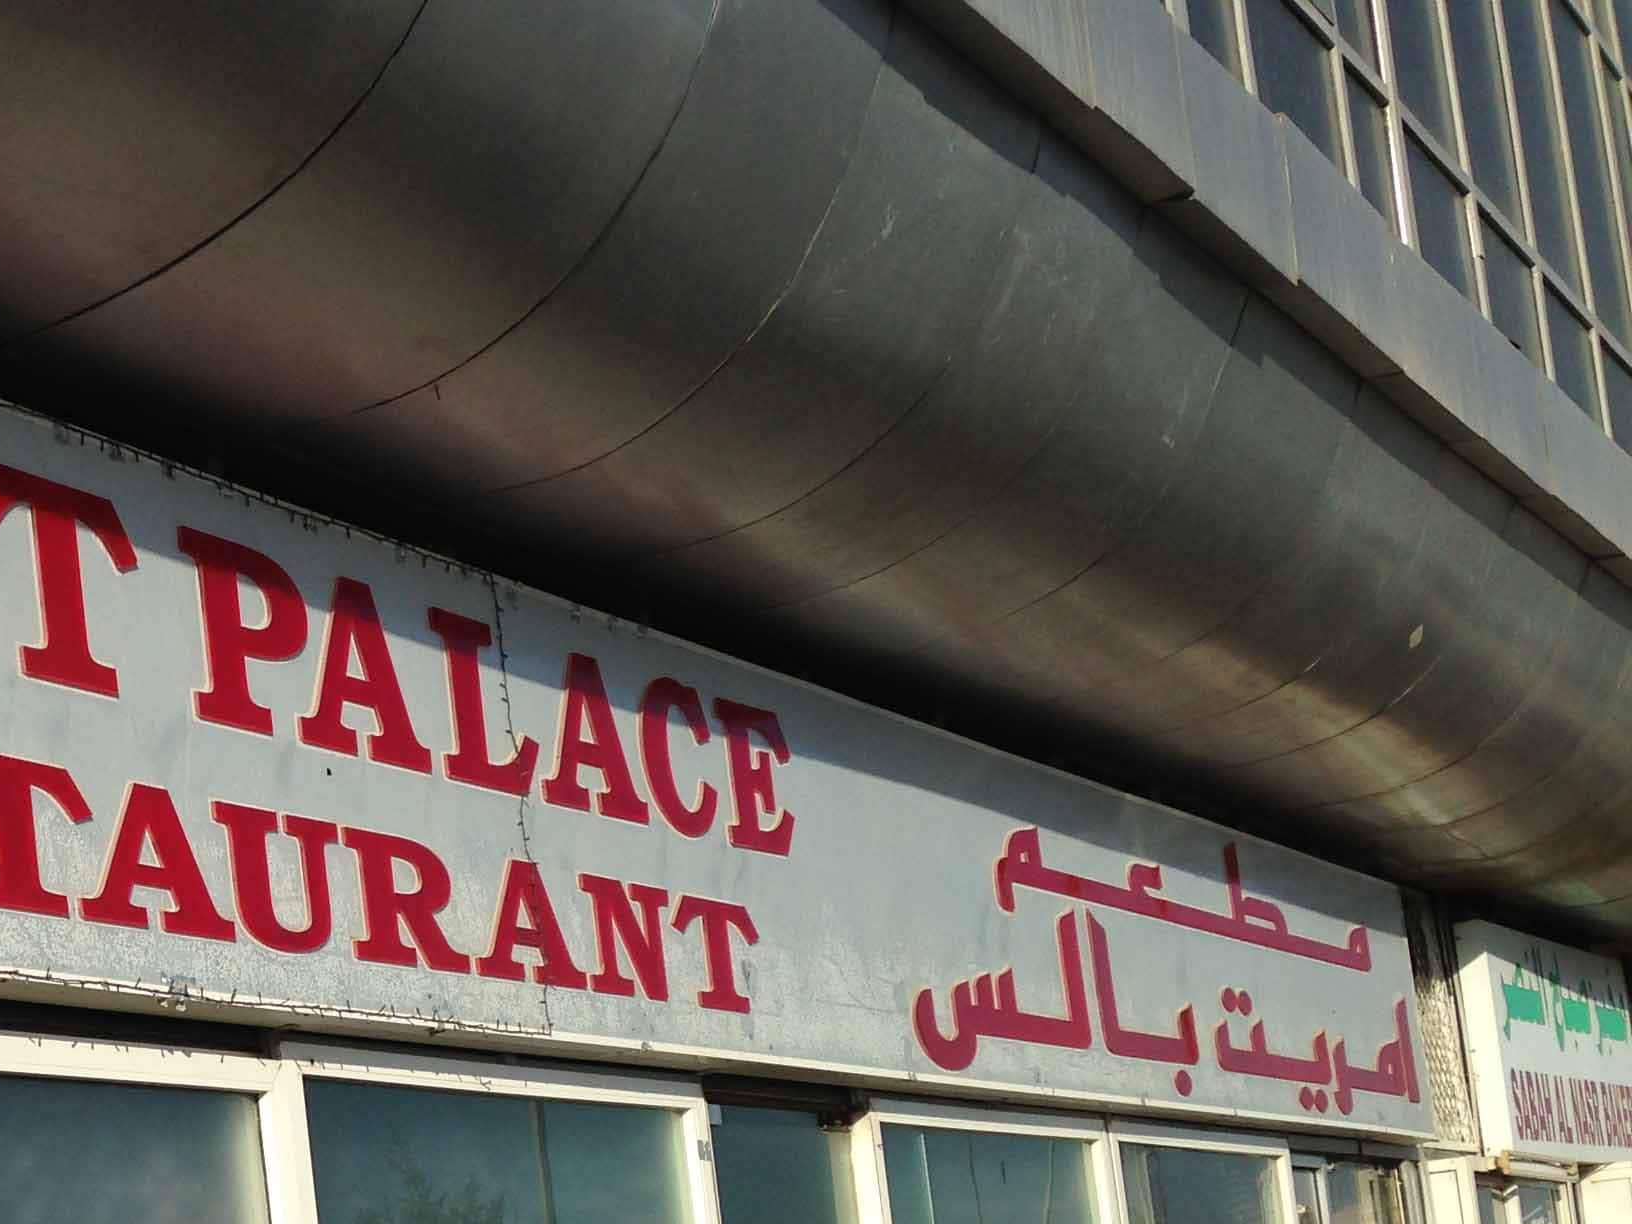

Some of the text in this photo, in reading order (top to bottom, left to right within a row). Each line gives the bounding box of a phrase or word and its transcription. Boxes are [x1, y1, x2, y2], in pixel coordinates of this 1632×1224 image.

[176, 524, 796, 857] PALACE
[993, 825, 1372, 973] مطعم
[913, 906, 1422, 1116] امريت بالس
[1510, 1067, 1556, 1143] SABAH
[1554, 1075, 1574, 1144] AL
[1569, 1077, 1606, 1147] NASR
